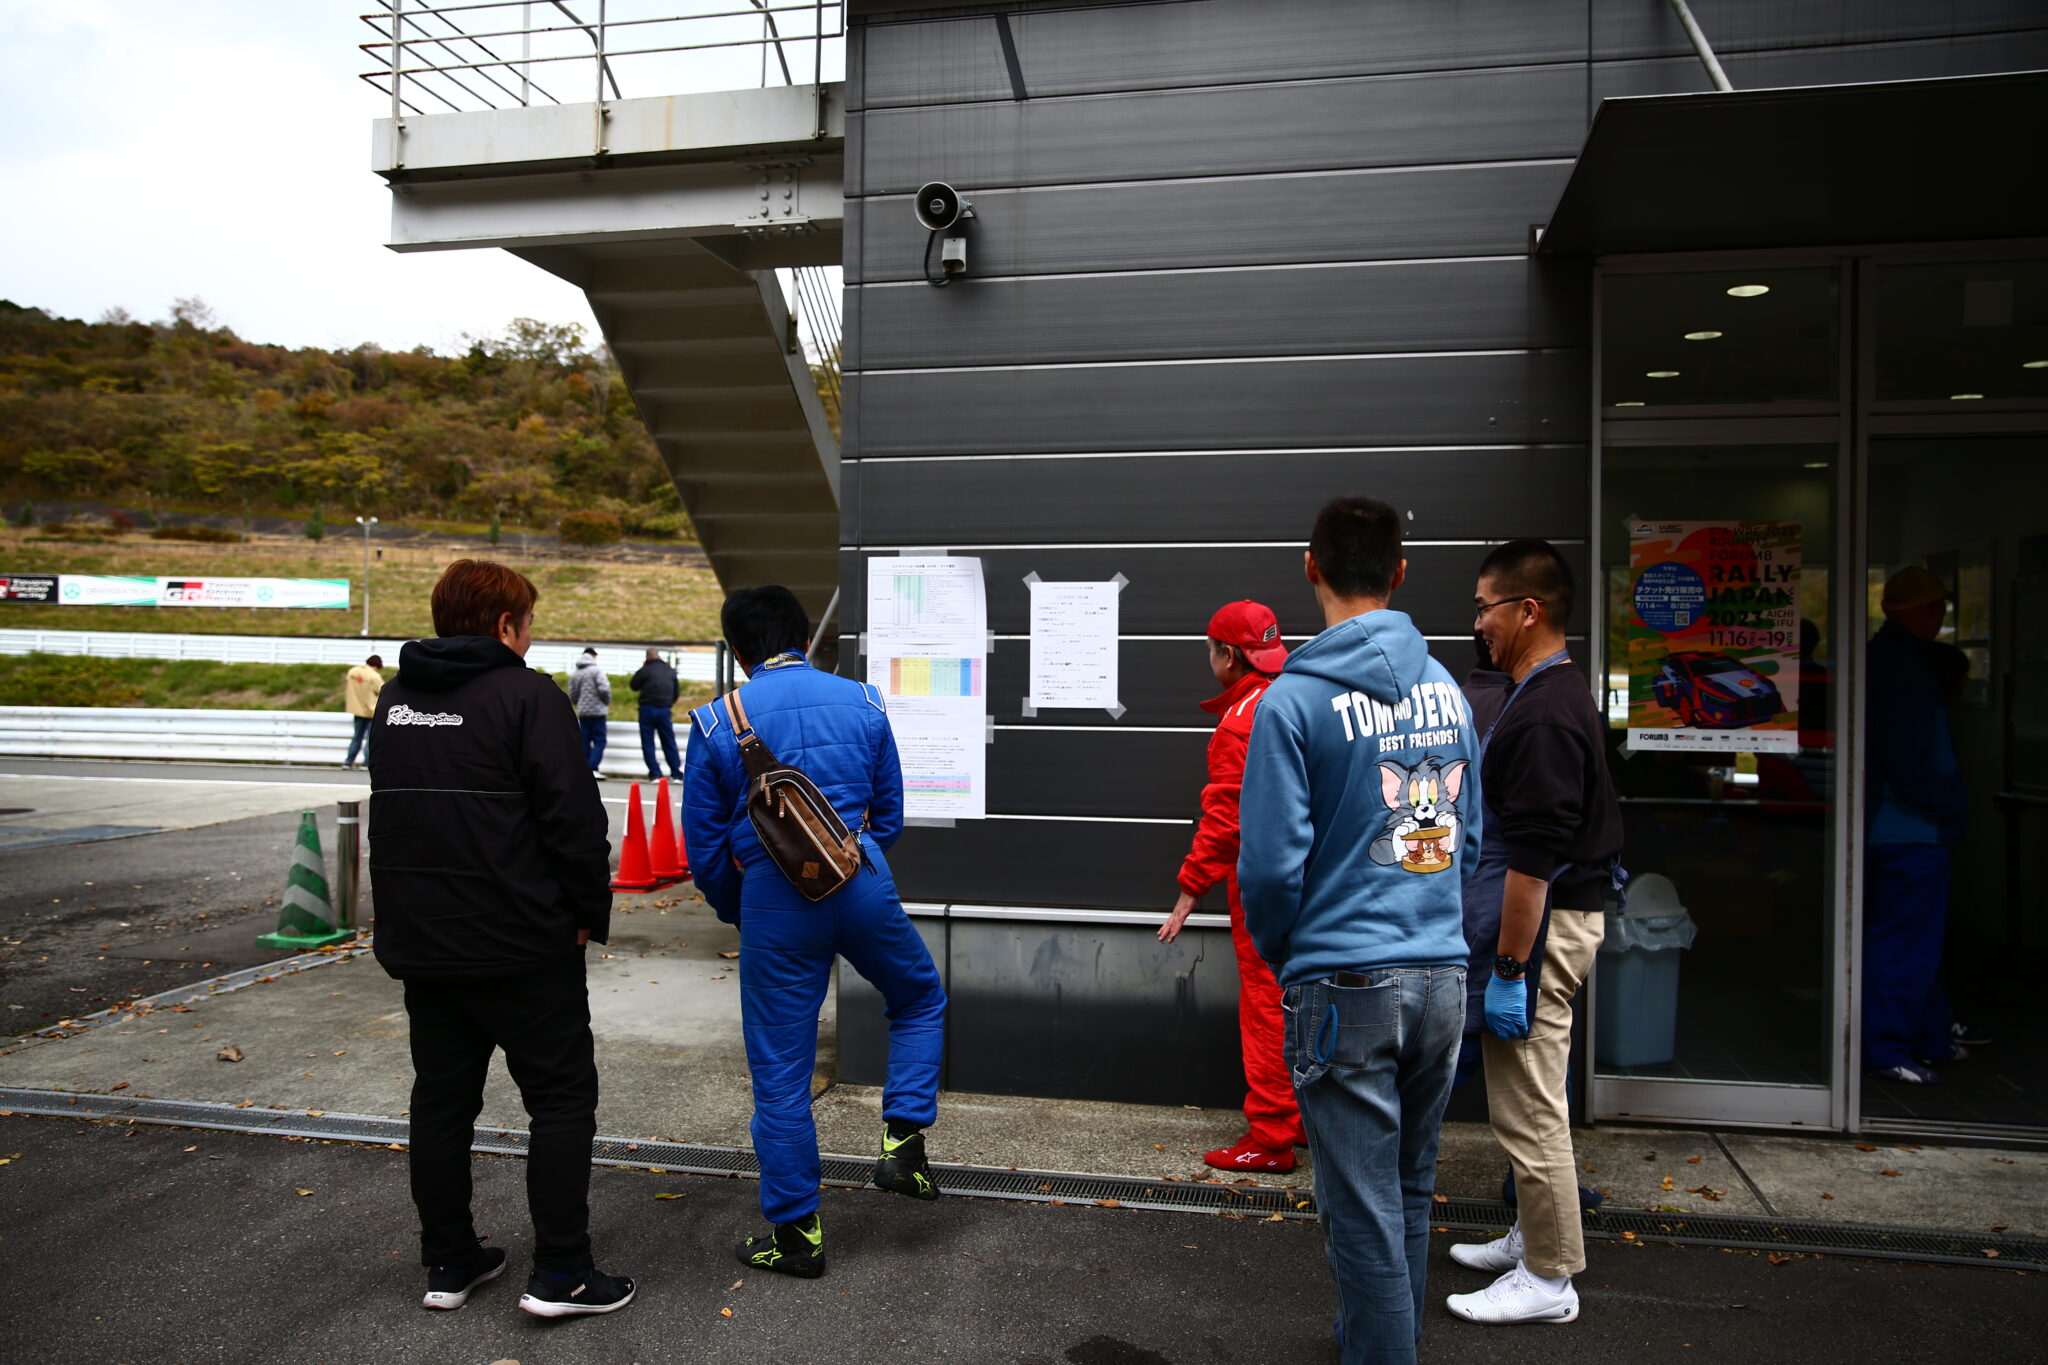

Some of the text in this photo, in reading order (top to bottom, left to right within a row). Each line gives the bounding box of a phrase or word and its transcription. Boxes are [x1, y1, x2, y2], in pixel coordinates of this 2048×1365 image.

[1710, 550, 1773, 561] FORUM8
[1709, 564, 1794, 582] RALLY
[1708, 587, 1793, 605] JAPAN
[1708, 610, 1794, 627] 2023 AICHI
[1707, 631, 1747, 646] 11.16
[1331, 691, 1396, 741] TOM
[1394, 697, 1412, 720] AND
[1379, 729, 1459, 752] BEST FRIENDS!
